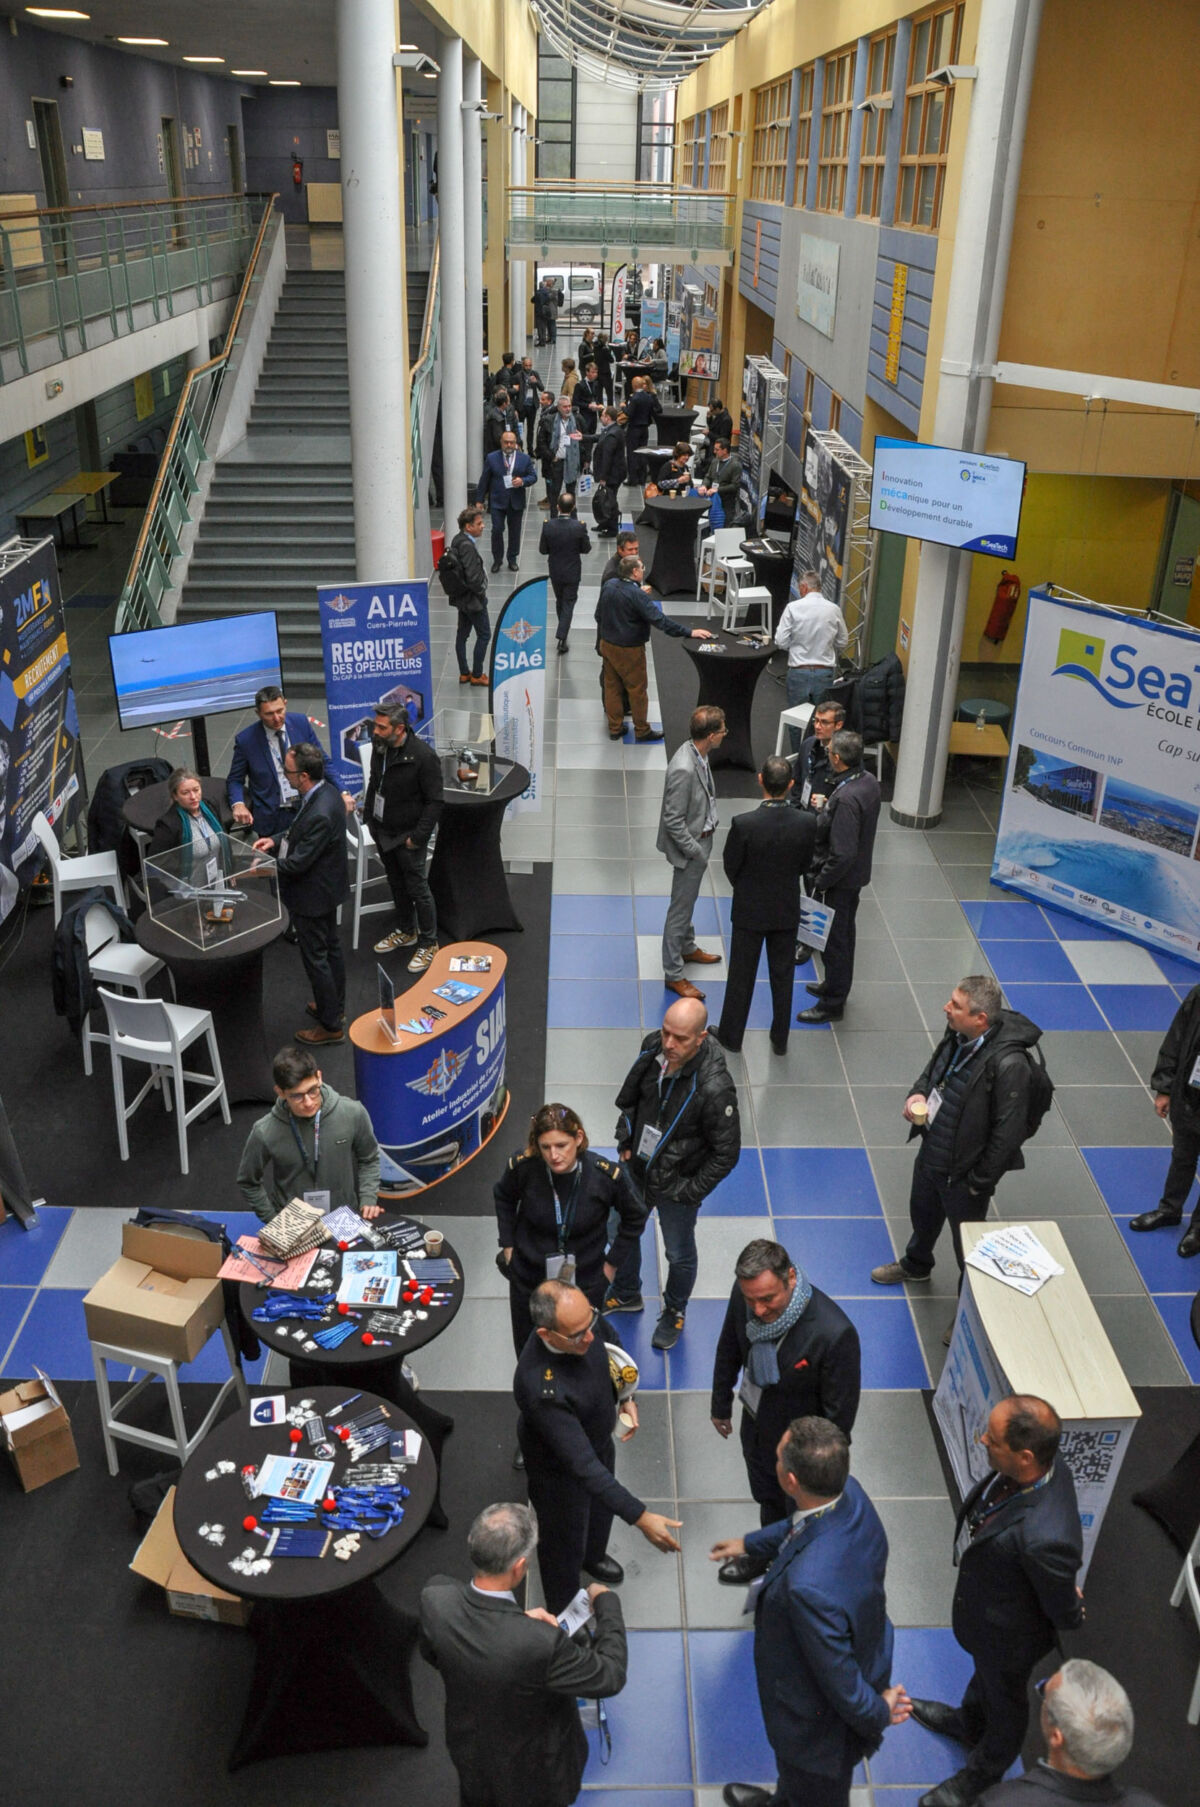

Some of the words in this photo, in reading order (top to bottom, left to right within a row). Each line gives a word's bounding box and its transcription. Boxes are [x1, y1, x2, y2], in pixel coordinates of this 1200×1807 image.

[882, 472, 923, 488] Innovation
[881, 487, 929, 504] mécanique
[931, 499, 954, 511] pour
[952, 503, 963, 512] un
[880, 500, 941, 522] Développement
[943, 516, 973, 529] durable
[367, 594, 418, 619] AIA
[366, 620, 418, 629] Cuers-Pierrefeu
[331, 638, 404, 664] RECRUTE
[494, 648, 543, 671] SIAé
[24, 643, 59, 689] RECRUTEMENT
[332, 663, 353, 675] DES
[355, 657, 423, 673] OPERATEURS
[1105, 643, 1200, 713] Sea
[1146, 702, 1194, 729] ÉCOLE
[1029, 728, 1067, 748] Concours
[1067, 741, 1106, 761] Commun
[1107, 756, 1124, 767] INP
[1158, 739, 1183, 758] Cap
[1066, 778, 1092, 790] SeaTech
[422, 1105, 448, 1126] Atelier
[449, 1080, 479, 1110] Industriel
[478, 1074, 486, 1084] de
[452, 1106, 461, 1117] de
